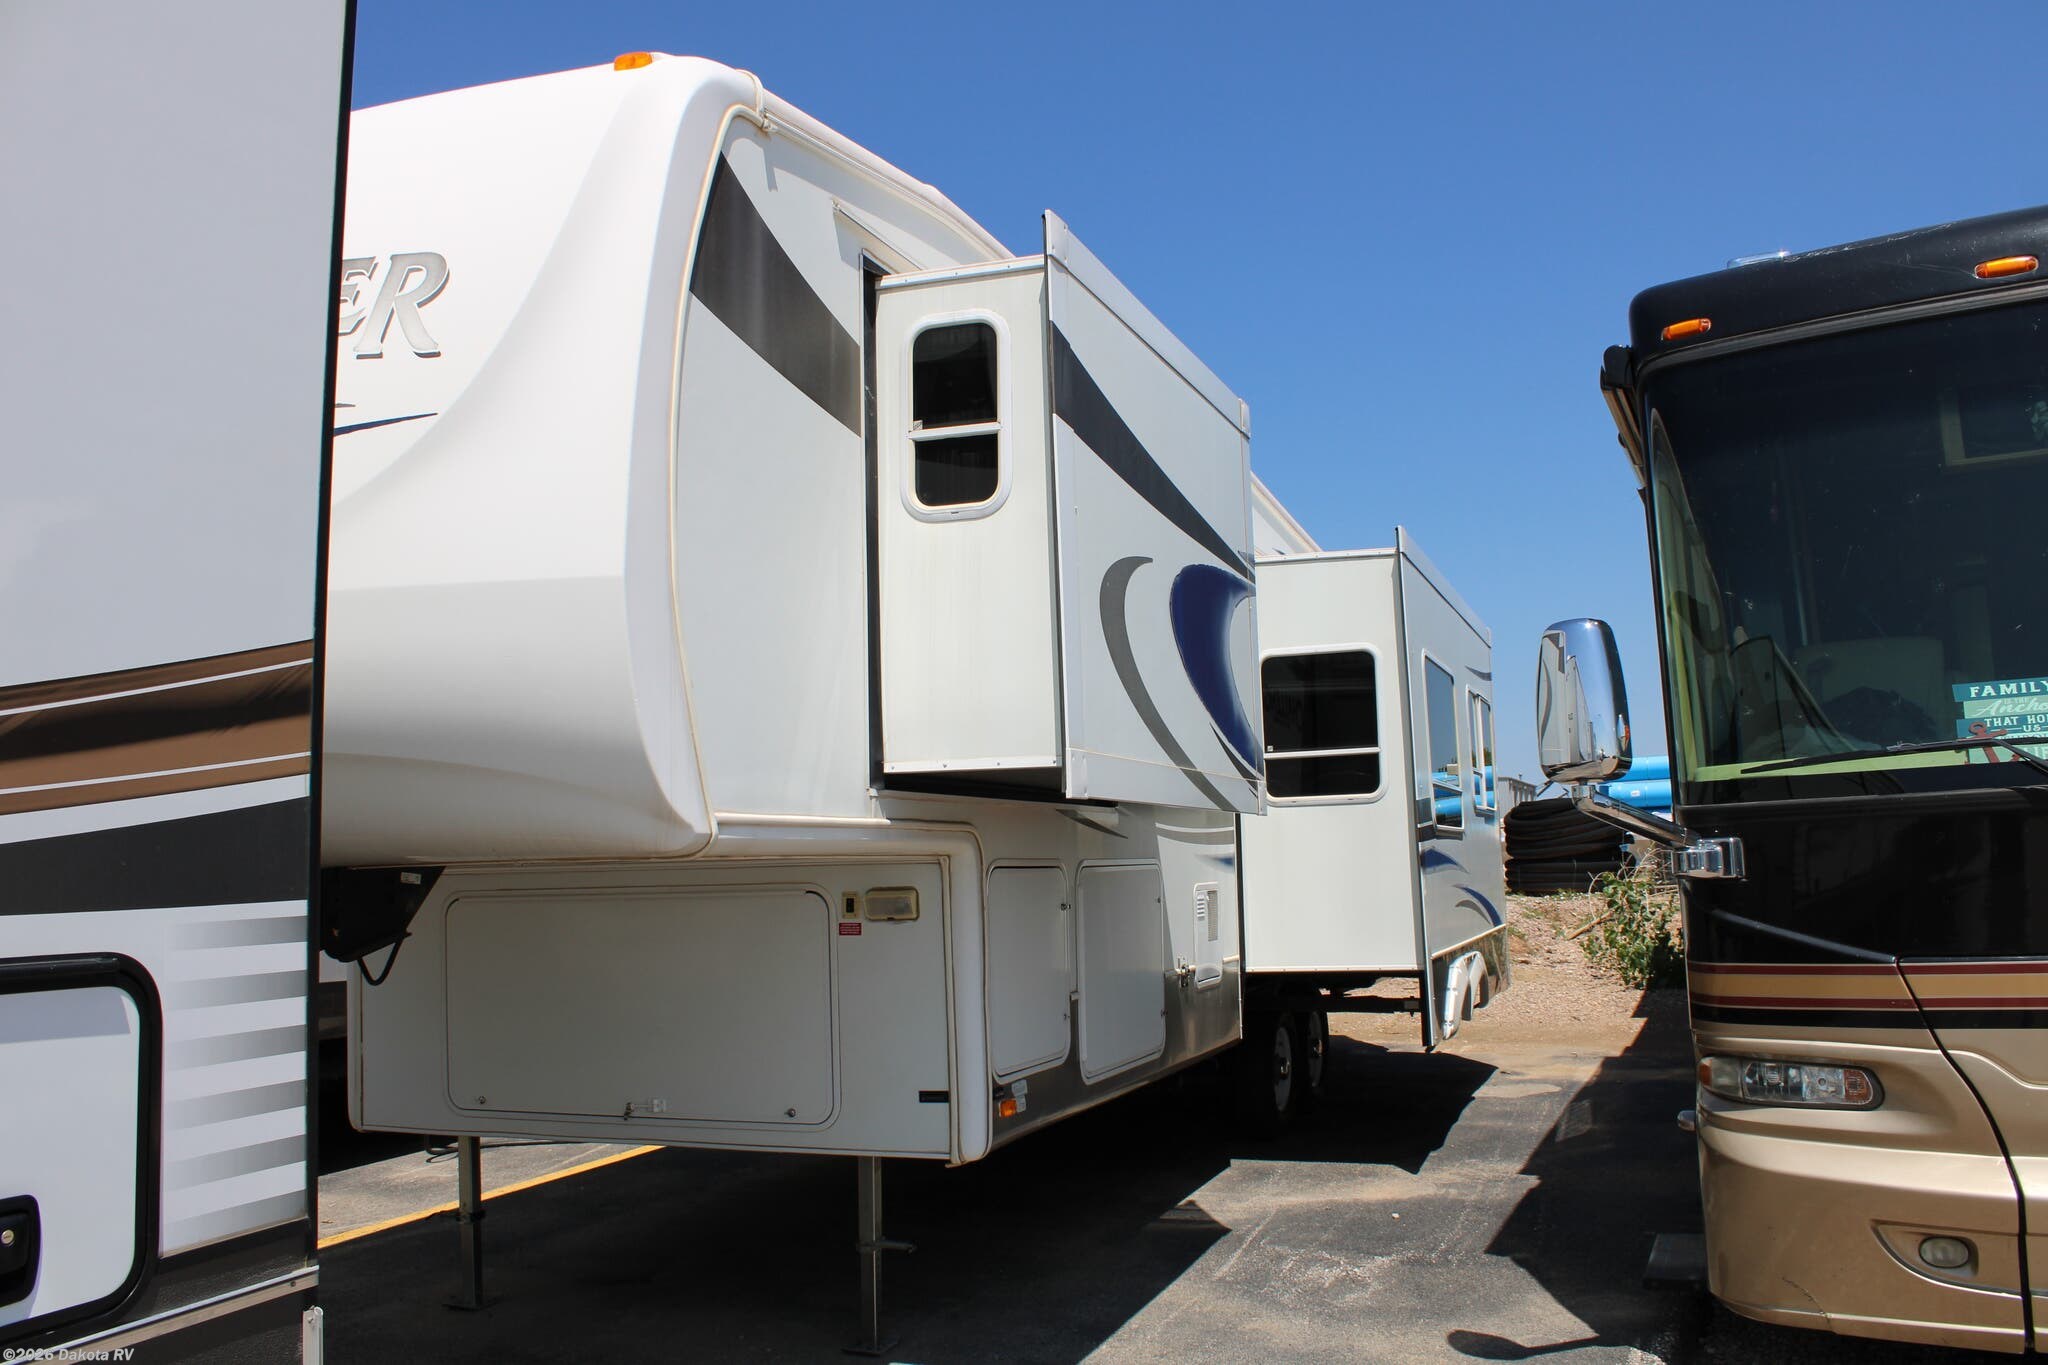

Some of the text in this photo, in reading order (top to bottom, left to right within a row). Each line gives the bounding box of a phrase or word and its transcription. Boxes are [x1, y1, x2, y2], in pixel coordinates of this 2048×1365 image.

[1984, 714, 2048, 727] THAT HO
[2023, 724, 2041, 732] US
